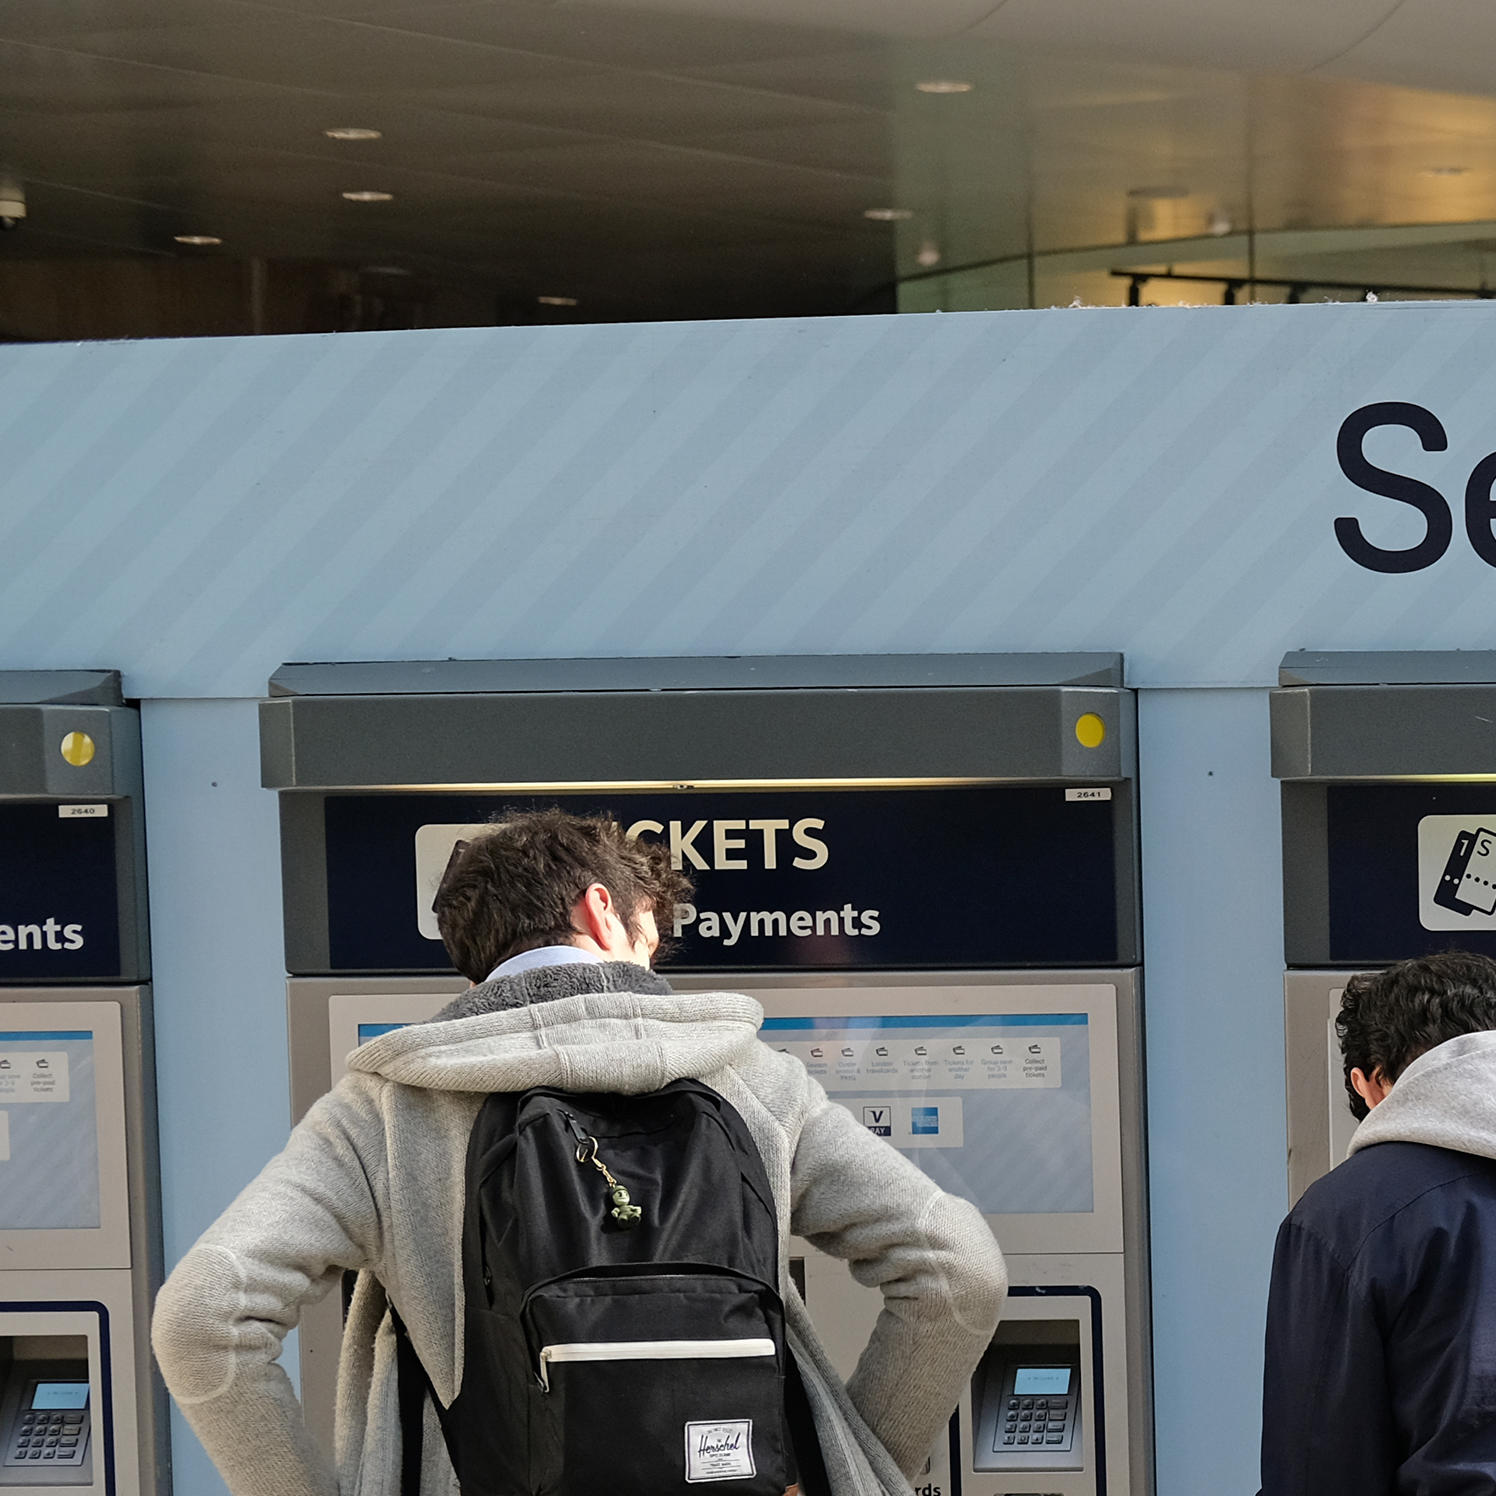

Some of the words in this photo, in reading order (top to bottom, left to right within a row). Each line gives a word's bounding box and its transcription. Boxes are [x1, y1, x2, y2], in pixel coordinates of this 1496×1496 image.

[625, 818, 829, 871] KETS
[0, 917, 83, 950] ents
[673, 904, 881, 945] Payments
[871, 1110, 884, 1124] V
[698, 1432, 740, 1458] Herschel
